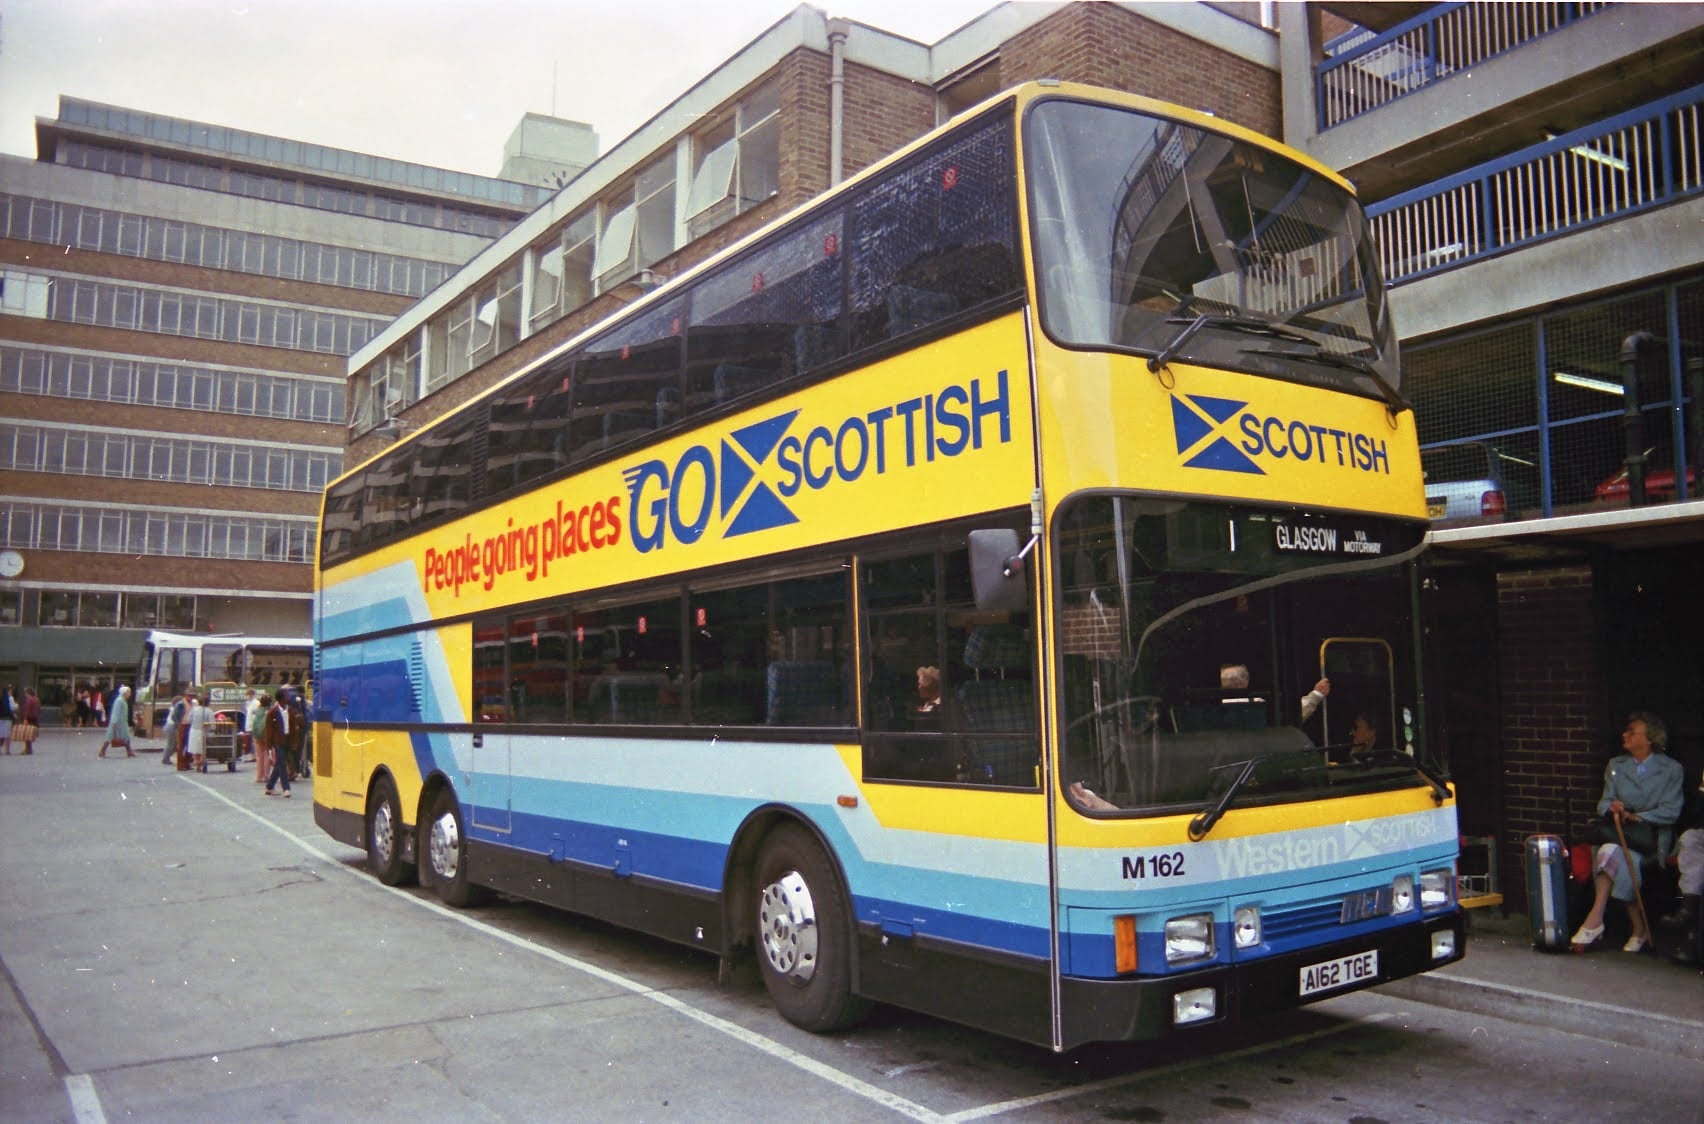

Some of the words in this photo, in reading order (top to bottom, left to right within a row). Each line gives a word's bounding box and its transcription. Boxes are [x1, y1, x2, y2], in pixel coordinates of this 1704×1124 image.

[1239, 413, 1390, 475] SCOTTISH
[424, 532, 481, 598] People
[482, 517, 539, 592] going
[541, 496, 621, 578] places
[622, 444, 716, 554] GO
[777, 370, 1010, 498] SCOTTISH
[1276, 525, 1337, 552] GLASGOW
[1343, 540, 1382, 554] MOTORWAY
[1353, 530, 1367, 542] VIA
[1214, 833, 1339, 880] Western
[1371, 815, 1438, 844] SCOTTISH
[1305, 962, 1340, 991] A162
[1343, 954, 1373, 980] TGE
